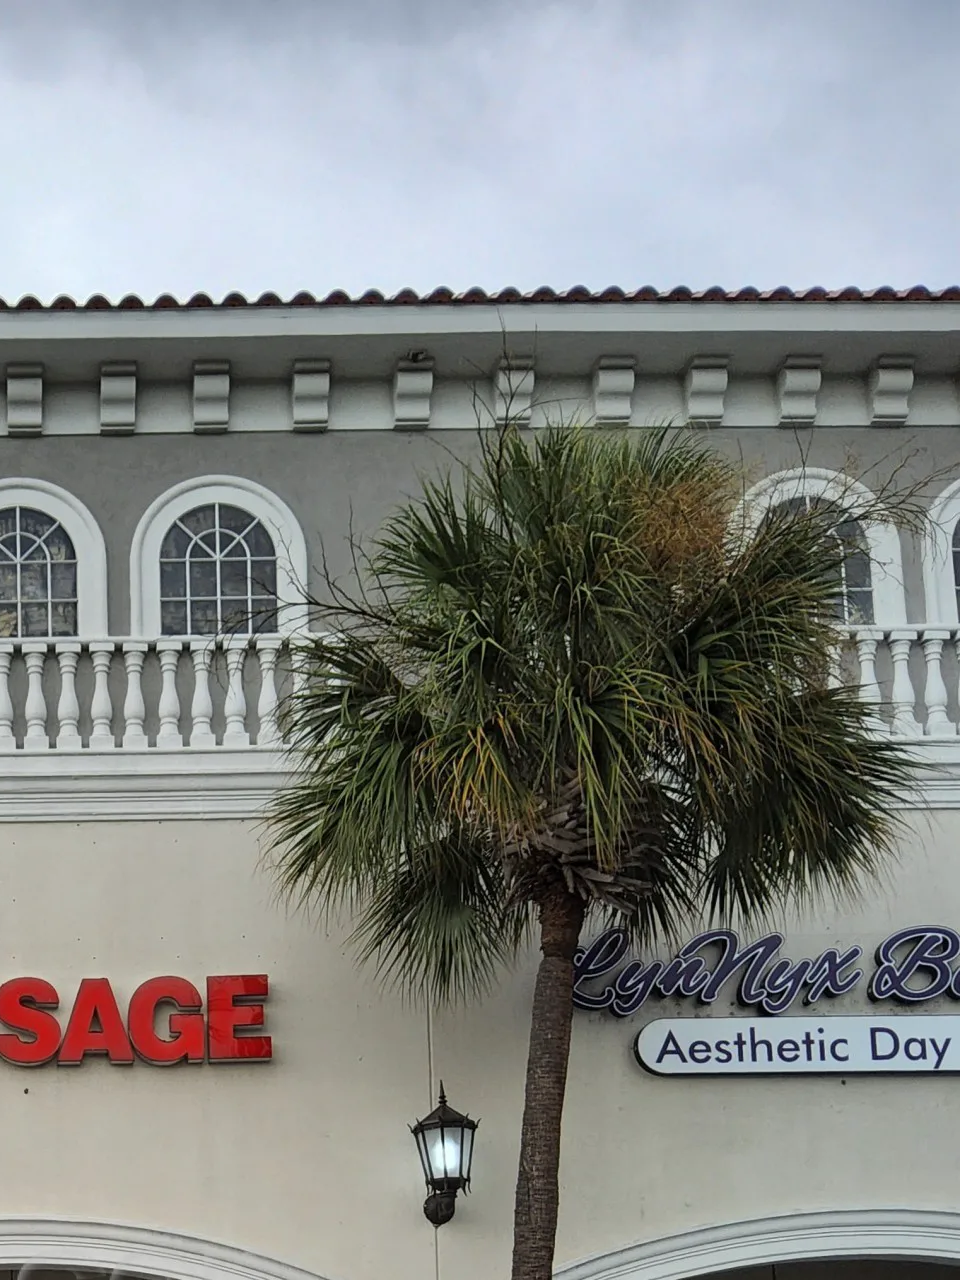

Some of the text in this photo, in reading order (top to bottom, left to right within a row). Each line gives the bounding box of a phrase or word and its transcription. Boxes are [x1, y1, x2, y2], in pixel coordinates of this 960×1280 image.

[872, 925, 960, 1002] B
[655, 1026, 952, 1070] Aesthetic Day
